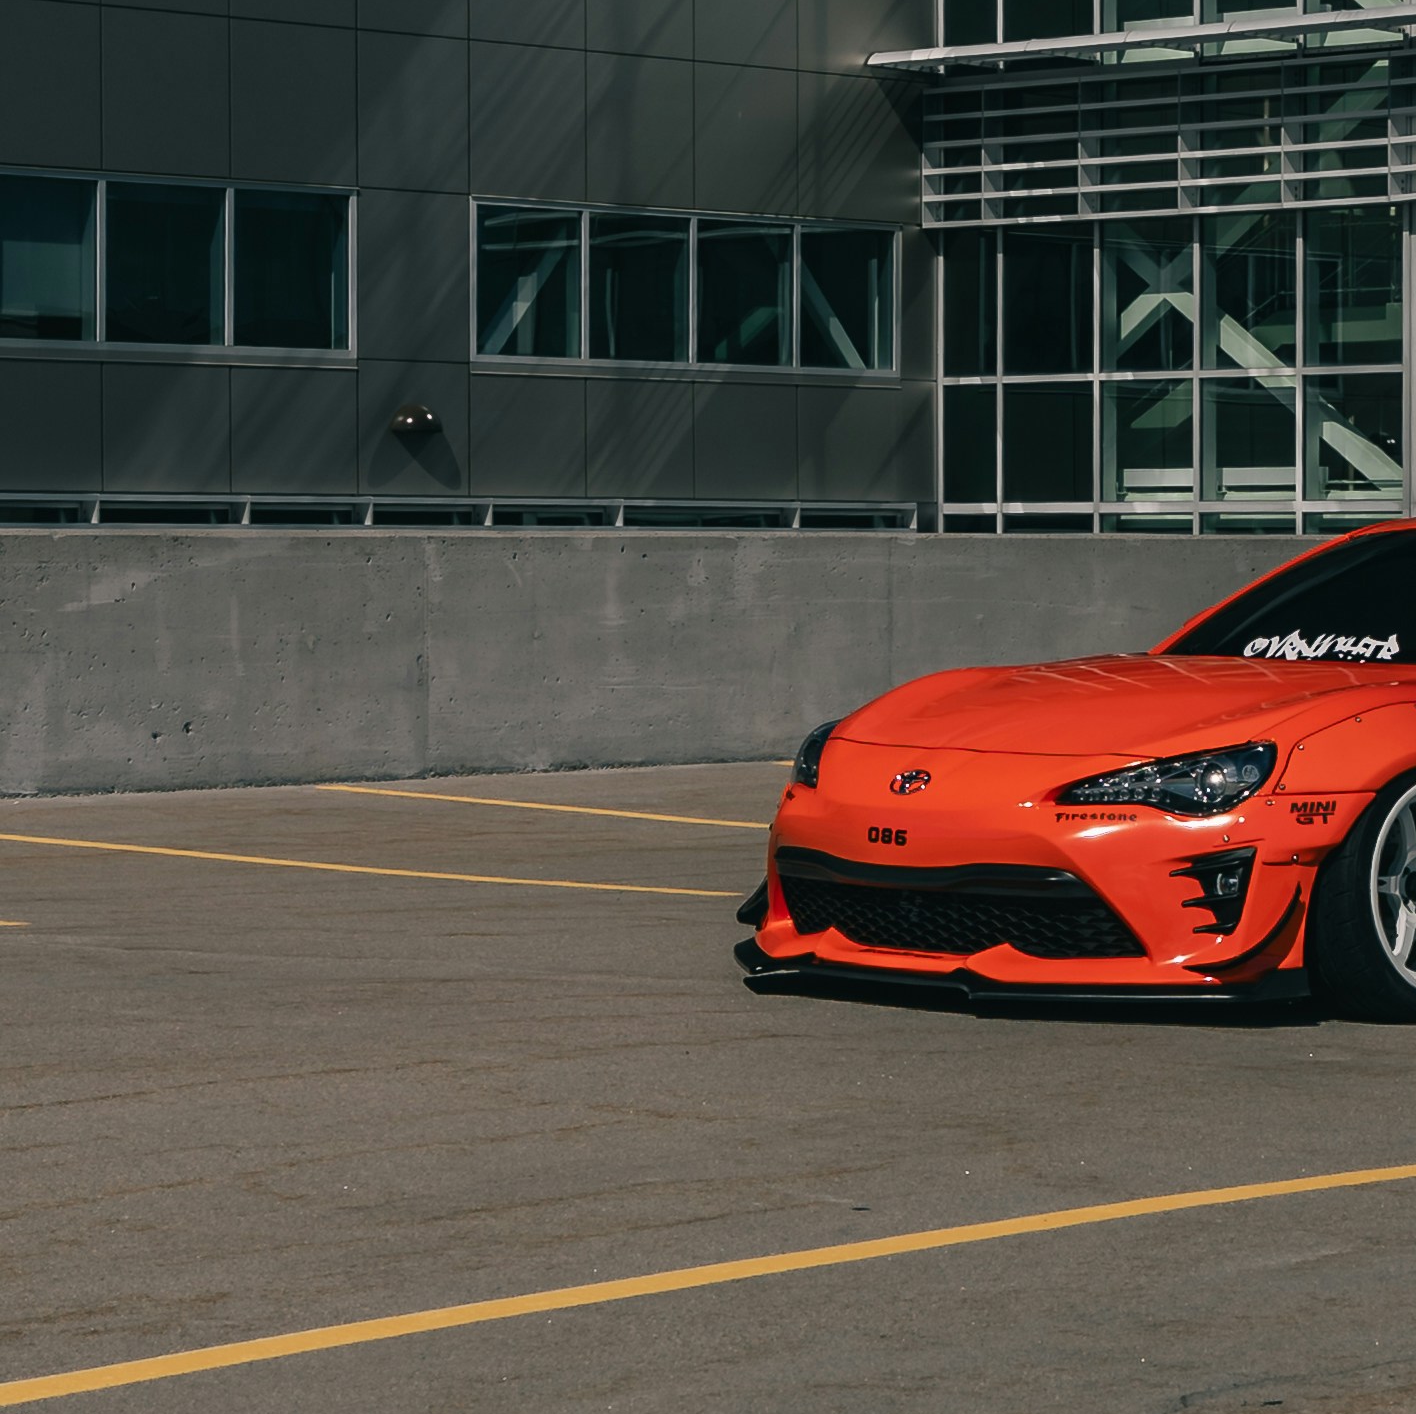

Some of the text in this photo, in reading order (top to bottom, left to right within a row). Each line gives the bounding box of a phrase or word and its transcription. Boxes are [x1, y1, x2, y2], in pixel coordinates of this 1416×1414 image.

[1290, 800, 1337, 813] MINI
[1055, 812, 1138, 823] Firestone
[1296, 812, 1334, 825] GT
[867, 826, 908, 847] 086
